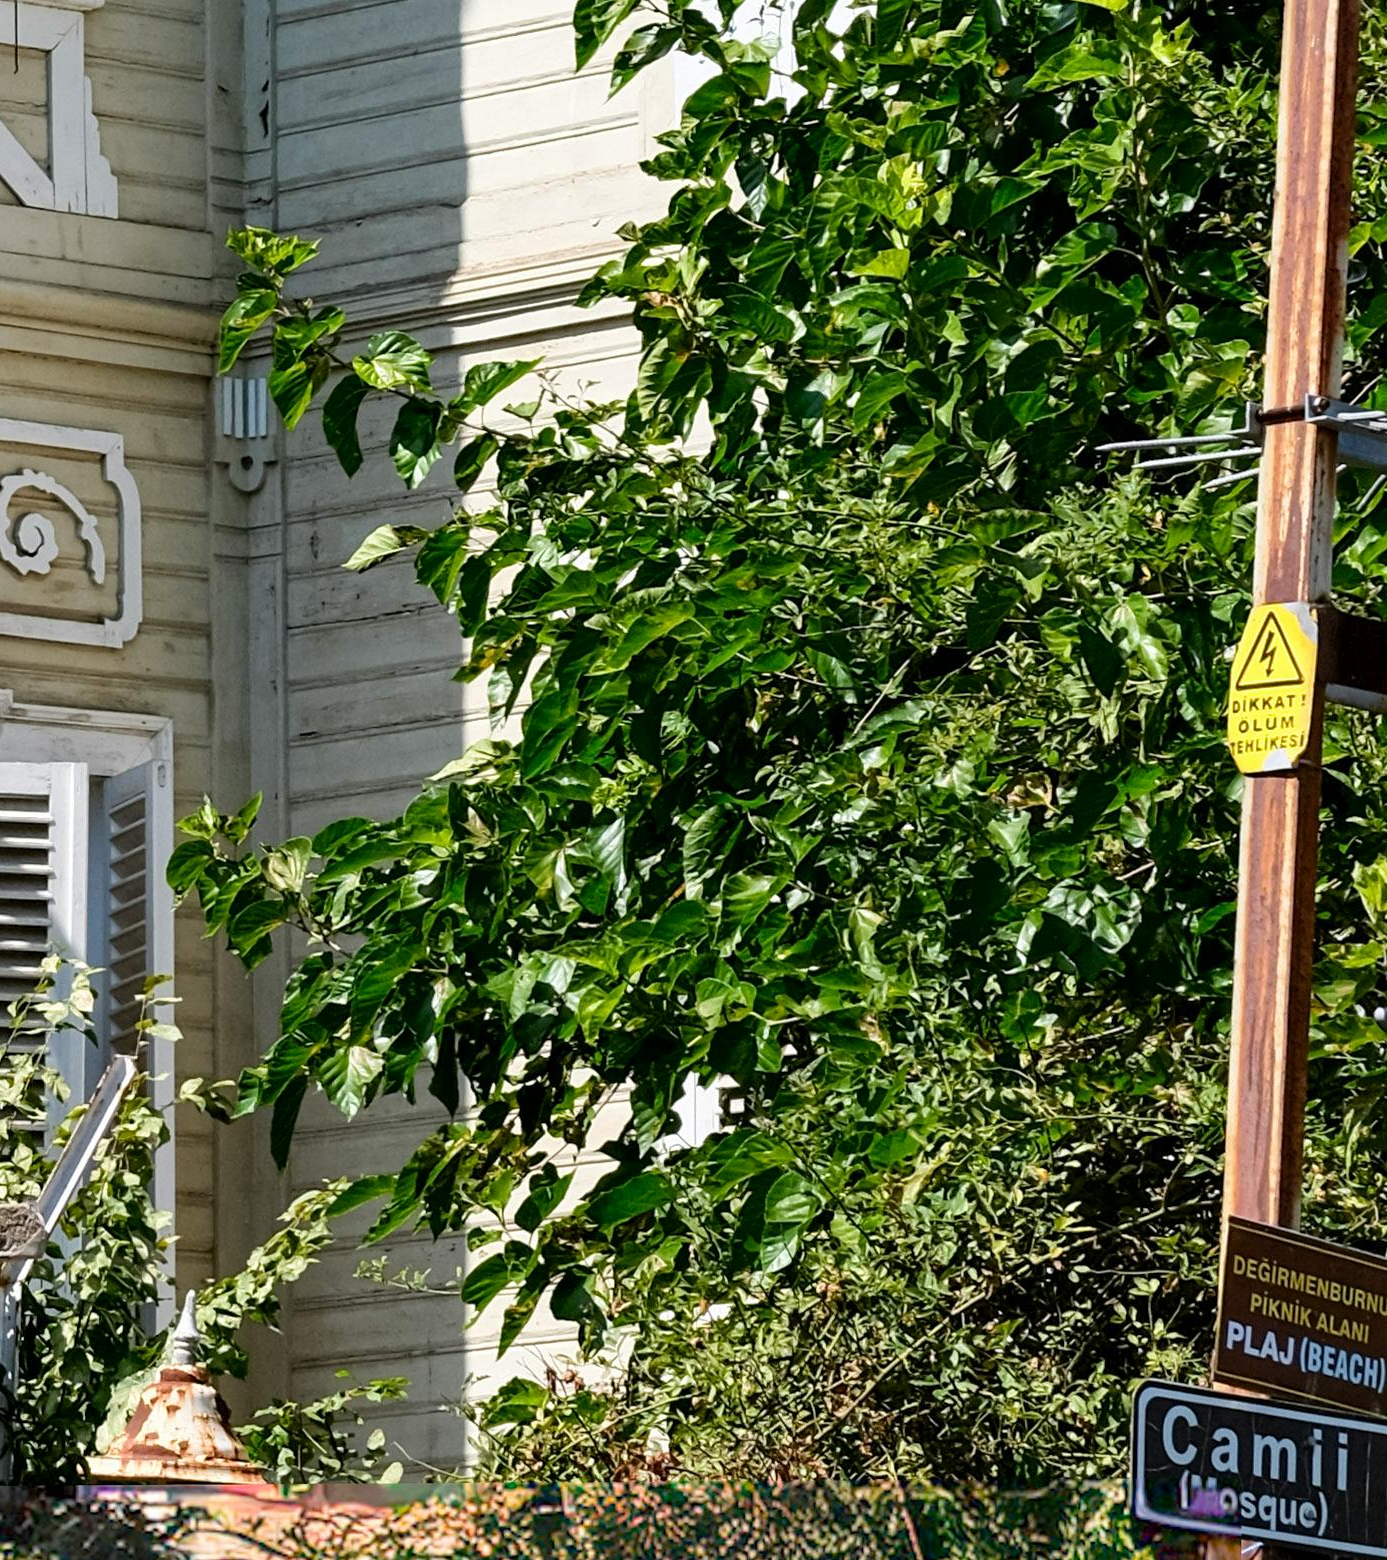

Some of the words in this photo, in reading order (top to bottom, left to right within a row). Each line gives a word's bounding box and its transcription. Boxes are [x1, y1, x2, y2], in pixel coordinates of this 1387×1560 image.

[1229, 731, 1305, 756] TEHLİKESİ
[1238, 714, 1295, 733] ÖLÜM
[1250, 1291, 1312, 1328] PİKNİK
[1315, 1312, 1370, 1344] ALANI
[1226, 1320, 1295, 1366] PLAJ
[1300, 1337, 1386, 1394] (BEACH)
[1162, 1405, 1348, 1491] Camii
[1179, 1469, 1328, 1537] (Mosque)
